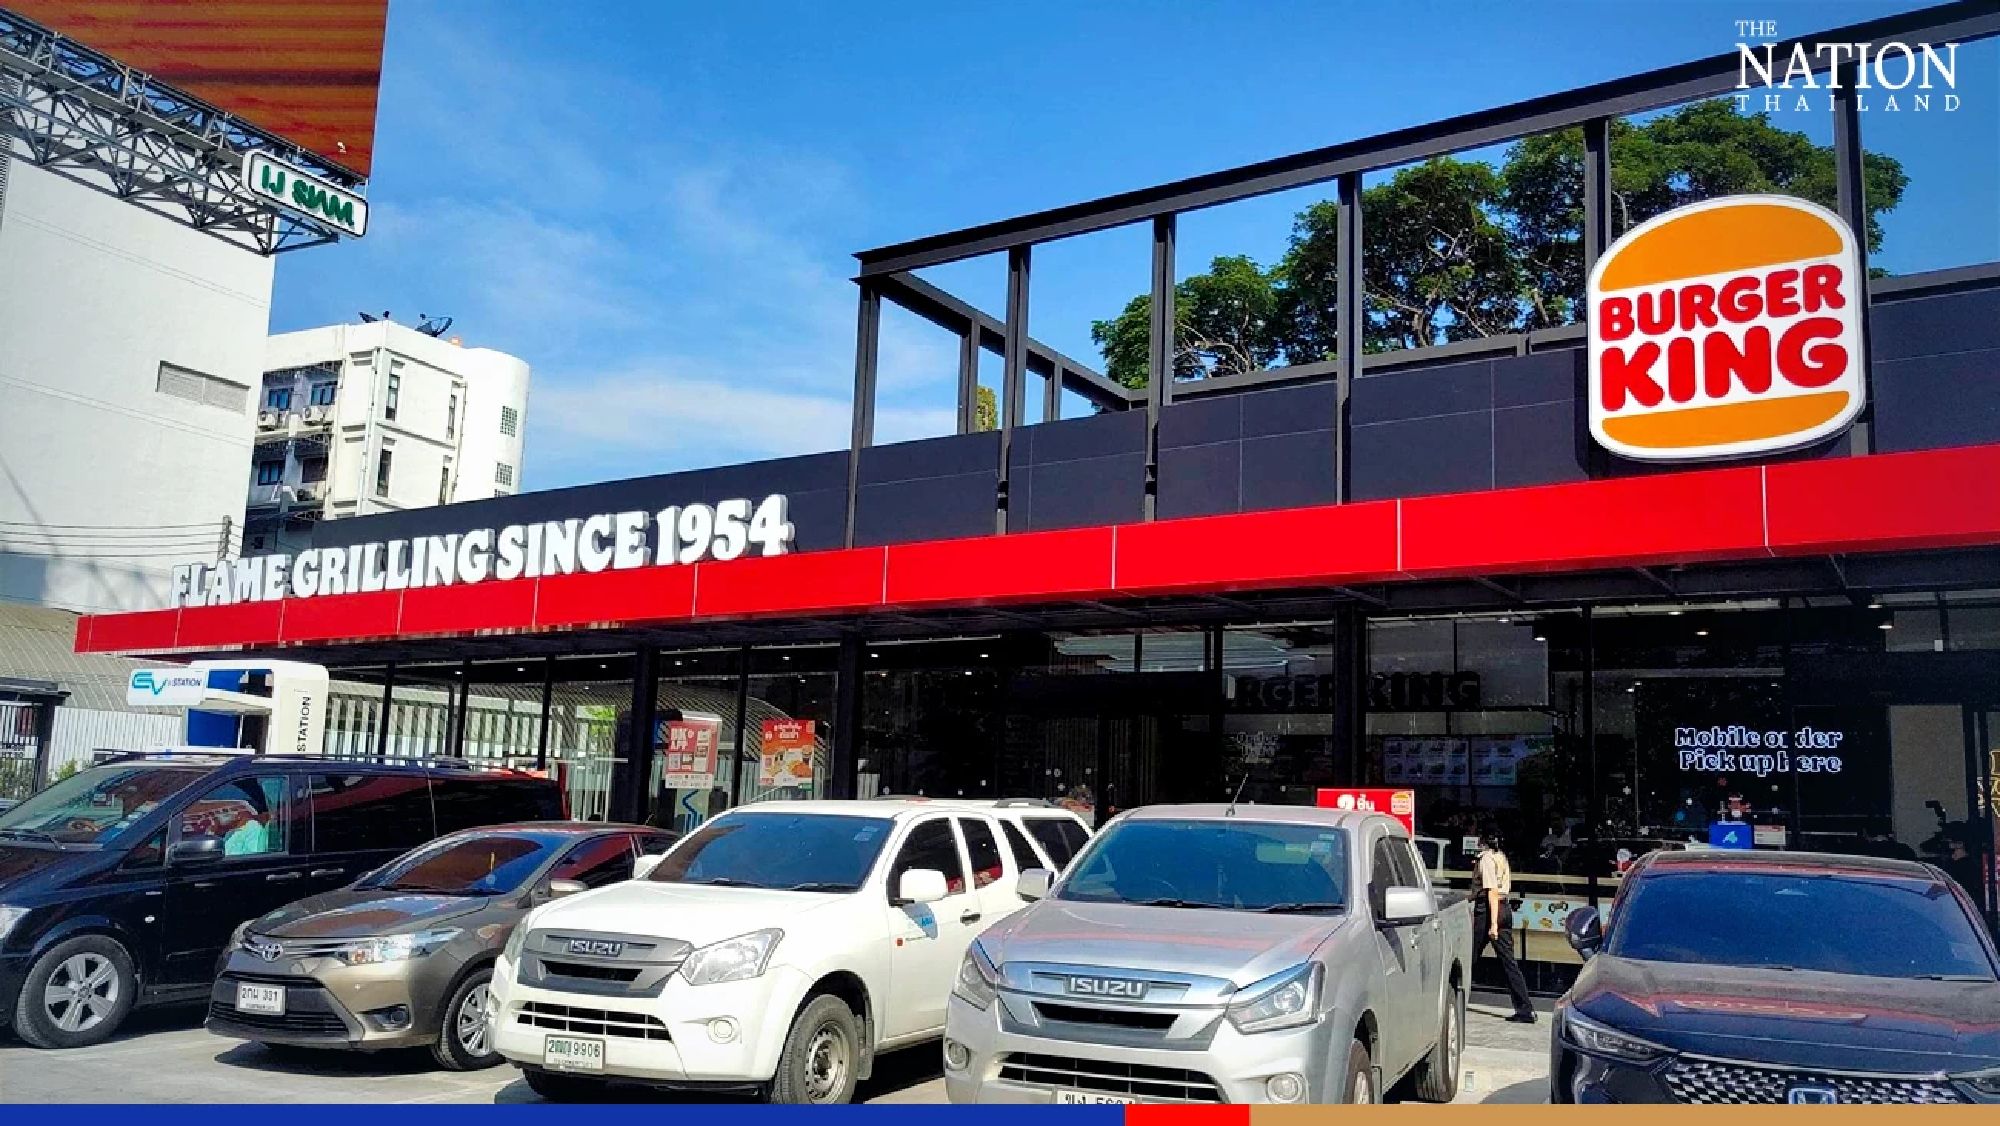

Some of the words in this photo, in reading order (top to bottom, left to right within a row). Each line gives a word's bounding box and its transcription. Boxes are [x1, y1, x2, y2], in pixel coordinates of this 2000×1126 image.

[292, 179, 354, 226] SIAM
[1600, 264, 1846, 342] BURGER
[1600, 317, 1848, 412] KING
[171, 554, 290, 608] FLAME
[292, 529, 495, 598] GRILLING
[498, 511, 650, 580] SINCE
[657, 494, 794, 566] 1954
[171, 676, 202, 688] STATION
[296, 696, 312, 752] STATION
[1674, 725, 1761, 748] Mobile
[1679, 748, 1736, 772] Pick
[1739, 754, 1775, 777] up
[570, 939, 620, 956] ISUZU
[1070, 977, 1142, 996] ISUZU
